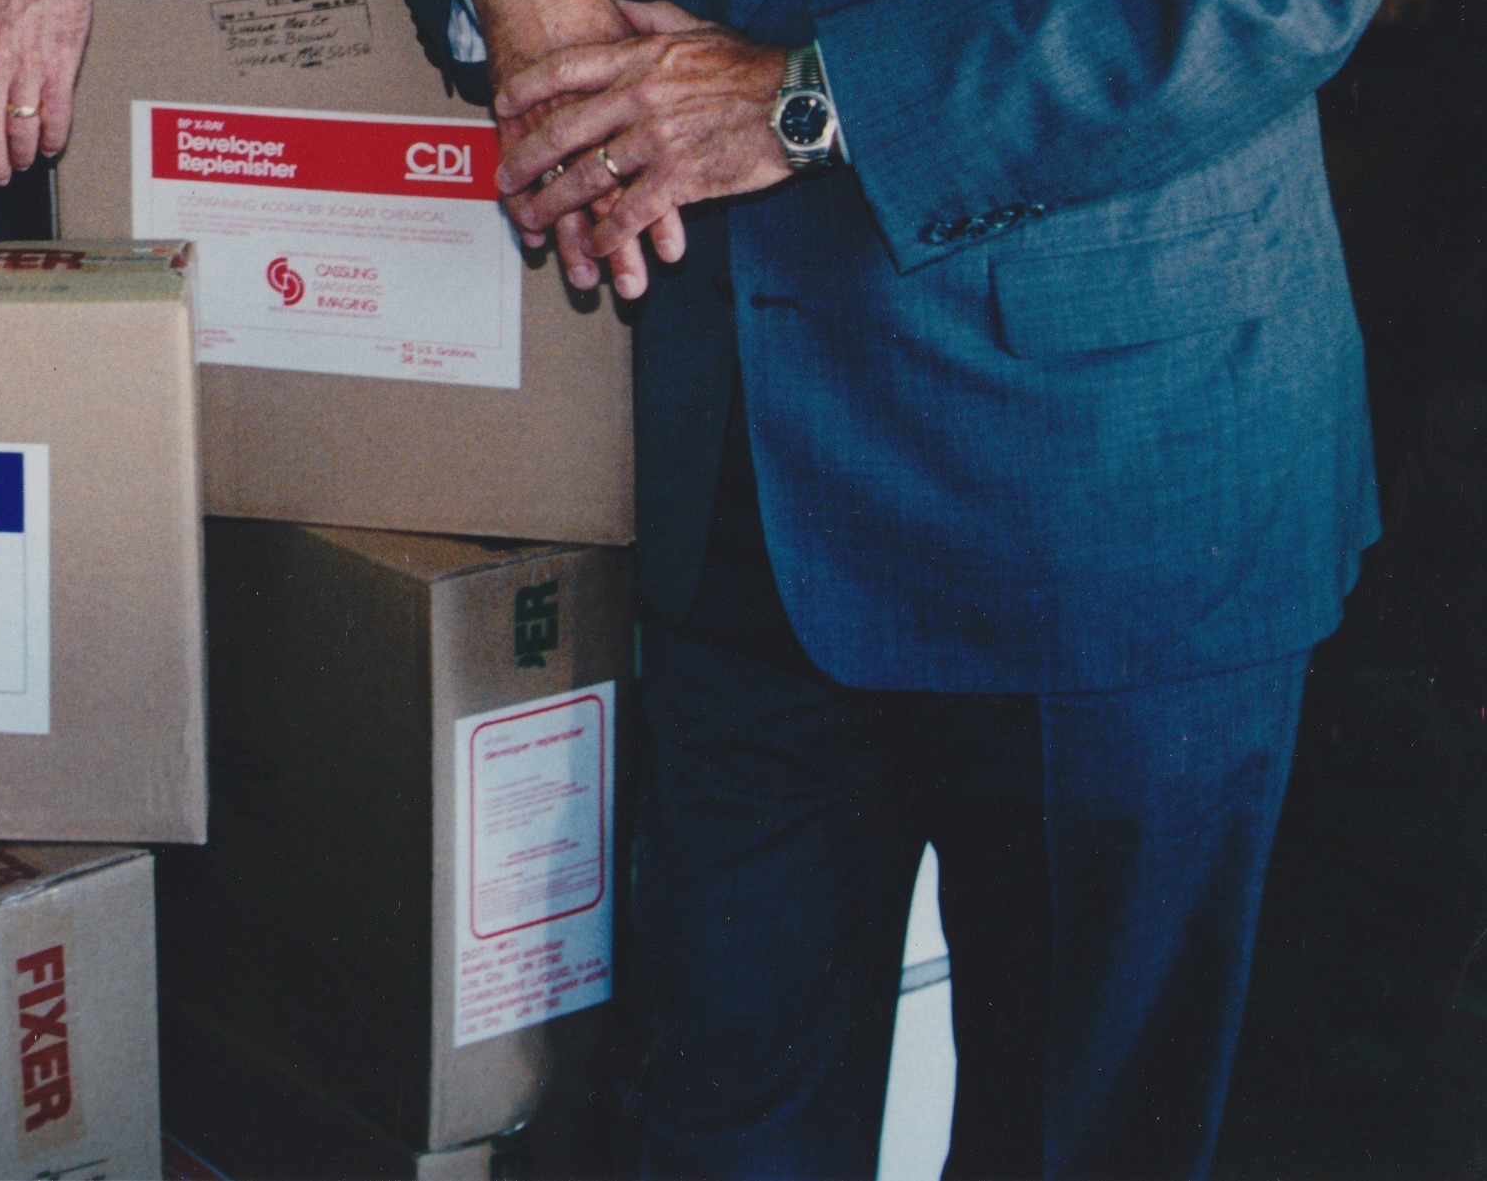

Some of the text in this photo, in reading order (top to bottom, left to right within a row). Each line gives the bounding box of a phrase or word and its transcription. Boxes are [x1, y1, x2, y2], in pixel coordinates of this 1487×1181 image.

[178, 131, 471, 176] Developer CDI
[178, 152, 297, 178] Replenisher
[260, 201, 304, 214] KODAK
[317, 295, 378, 312] IMAGING
[16, 944, 72, 1133] FIXER
